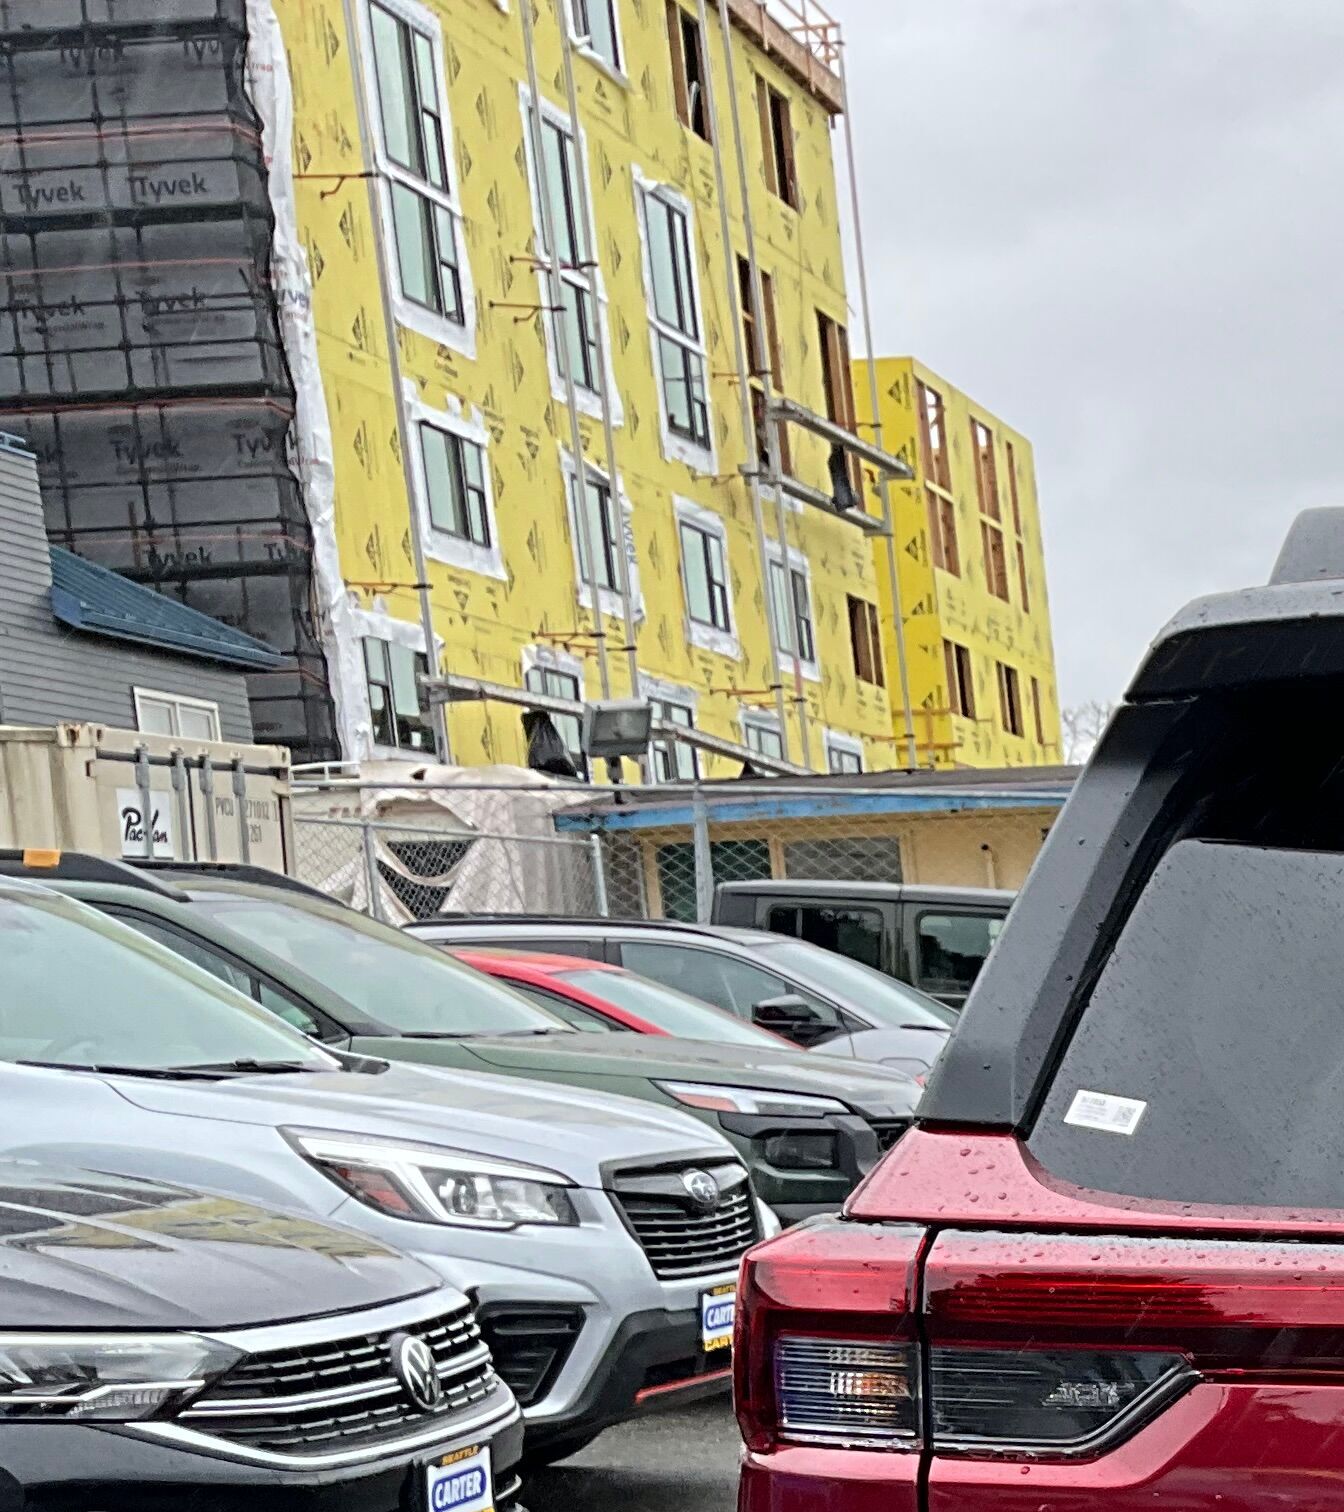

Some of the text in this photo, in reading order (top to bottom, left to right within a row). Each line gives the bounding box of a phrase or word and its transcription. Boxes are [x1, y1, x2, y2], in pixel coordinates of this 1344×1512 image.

[13, 179, 86, 211] Tyvek
[129, 172, 208, 202] Tyvek
[704, 1335, 734, 1351] CART
[435, 1470, 481, 1509] CARTER
